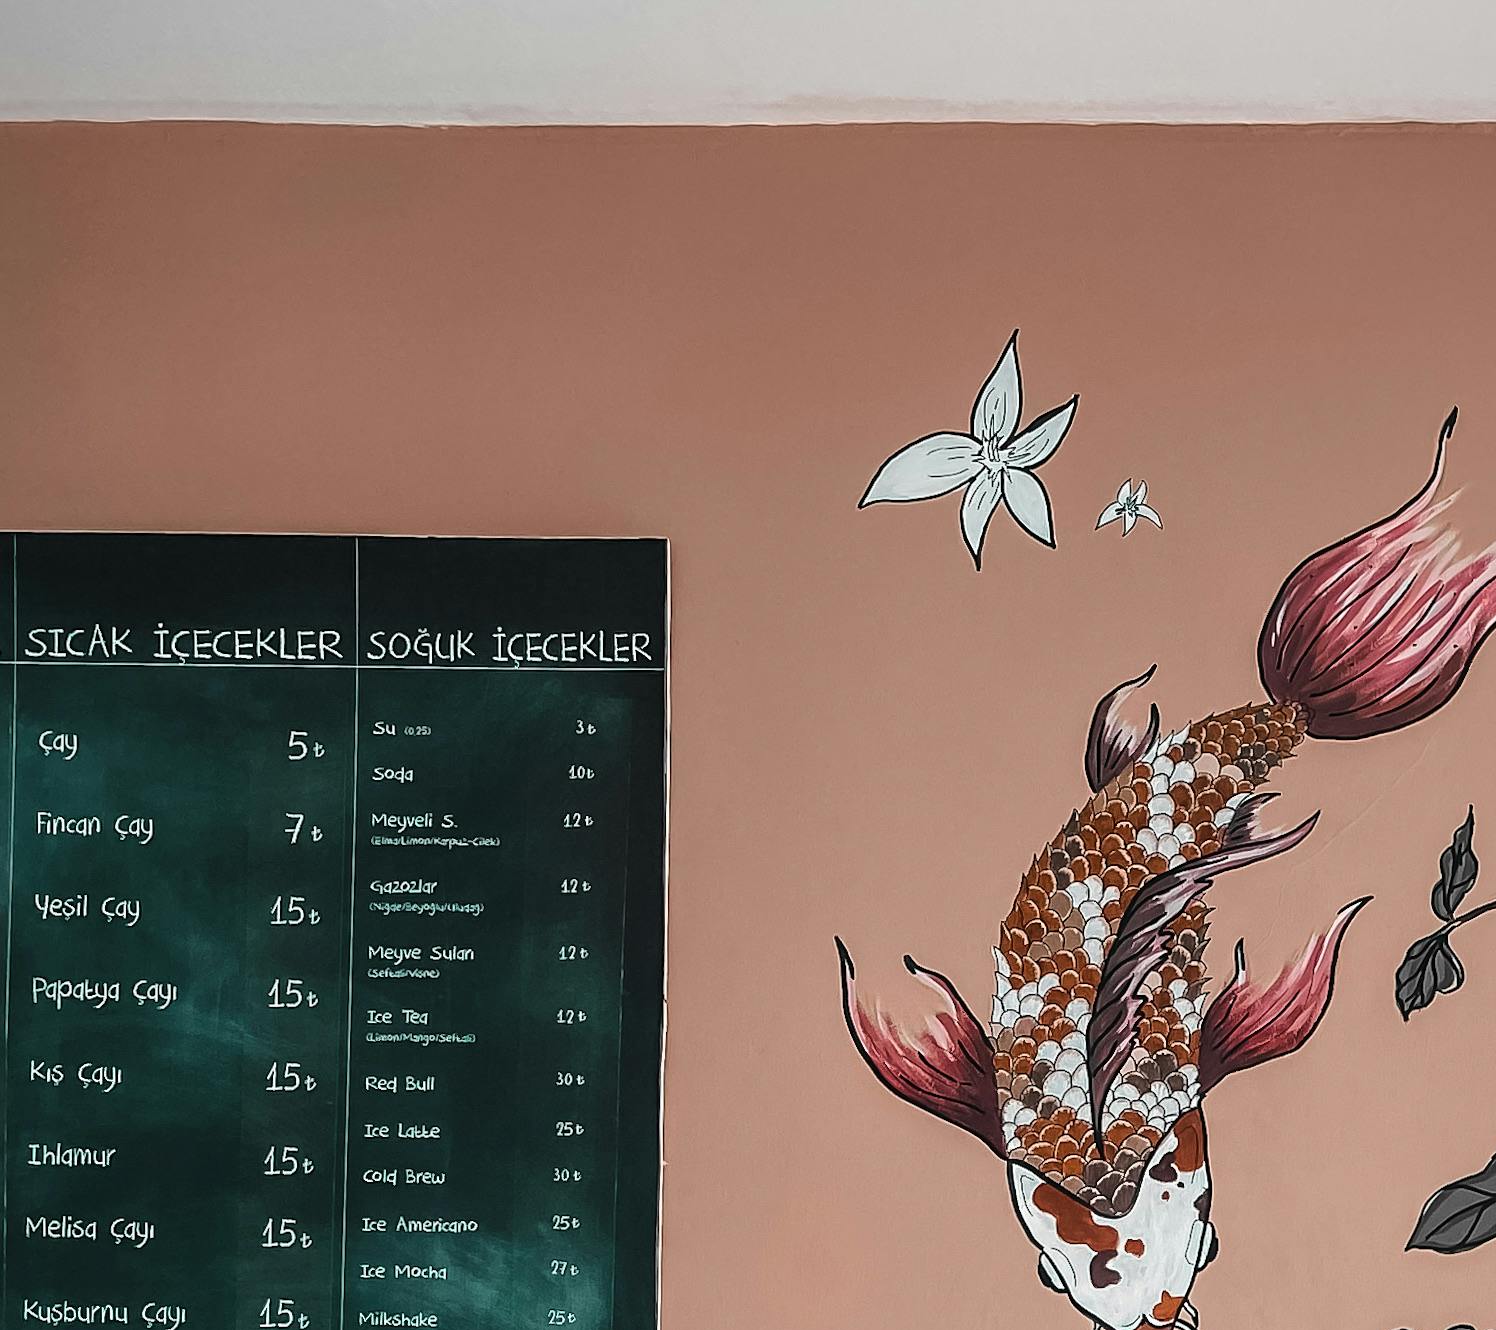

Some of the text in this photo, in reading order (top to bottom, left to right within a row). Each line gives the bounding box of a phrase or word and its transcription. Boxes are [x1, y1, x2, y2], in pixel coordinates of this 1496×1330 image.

[154, 622, 343, 663] İÇECEKLER
[367, 626, 653, 669] SOĞUK İÇECEKLER
[373, 722, 395, 735] Su
[39, 731, 77, 760] Çay
[373, 767, 413, 783] Soda
[38, 812, 100, 836] Fincan
[115, 816, 152, 844] Çay
[372, 813, 432, 833] Meyveli
[442, 815, 457, 828] S.
[370, 879, 437, 894] Gazozlar
[35, 894, 87, 920] Yeşil
[102, 897, 139, 926] Çay
[369, 946, 421, 965] Meyve
[33, 977, 119, 1009] Papatya
[133, 980, 177, 1009] Çayı
[367, 1011, 392, 1023] Ice
[402, 1009, 428, 1024] Tea
[31, 1060, 63, 1085] Kış
[78, 1063, 121, 1092] Çayı
[366, 1077, 397, 1093] Red
[406, 1076, 434, 1091] Bull
[364, 1125, 389, 1137] Ice
[398, 1123, 440, 1138] Latte
[28, 1143, 116, 1167] Ihlamur
[363, 1169, 397, 1186] Cold
[406, 1169, 445, 1184] Brew
[26, 1216, 96, 1240] Melisa
[111, 1219, 154, 1248] Çayı
[362, 1218, 386, 1231] Ice
[397, 1217, 478, 1233] Americano
[360, 1265, 385, 1278] Ice
[395, 1265, 446, 1279] Mocha
[24, 1300, 127, 1326] Kuşburnu
[359, 1312, 437, 1327] Milkshake
